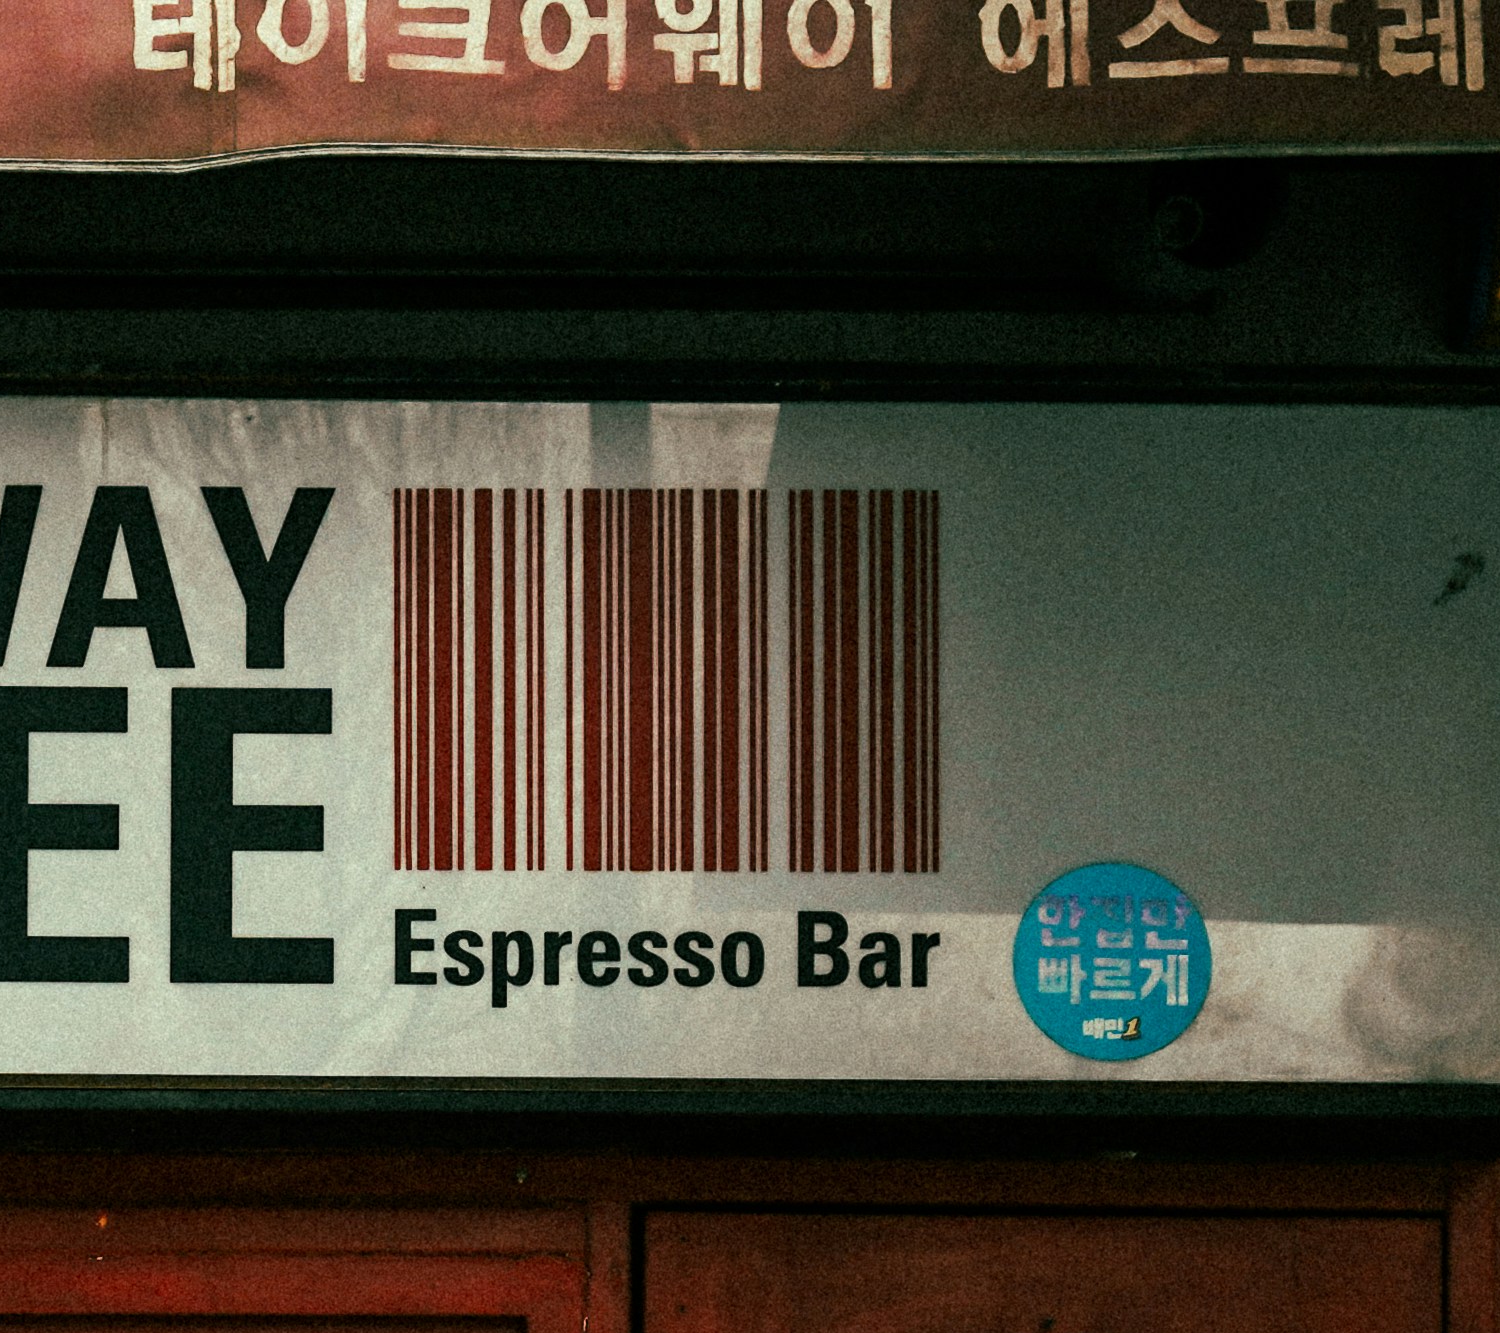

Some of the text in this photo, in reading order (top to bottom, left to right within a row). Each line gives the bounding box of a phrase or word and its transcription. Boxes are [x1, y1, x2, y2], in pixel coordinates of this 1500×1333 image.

[134, 0, 893, 92] 테이크어웨이
[394, 909, 940, 1008] Espresso Bar
[1037, 954, 1189, 1006] 빠르게
